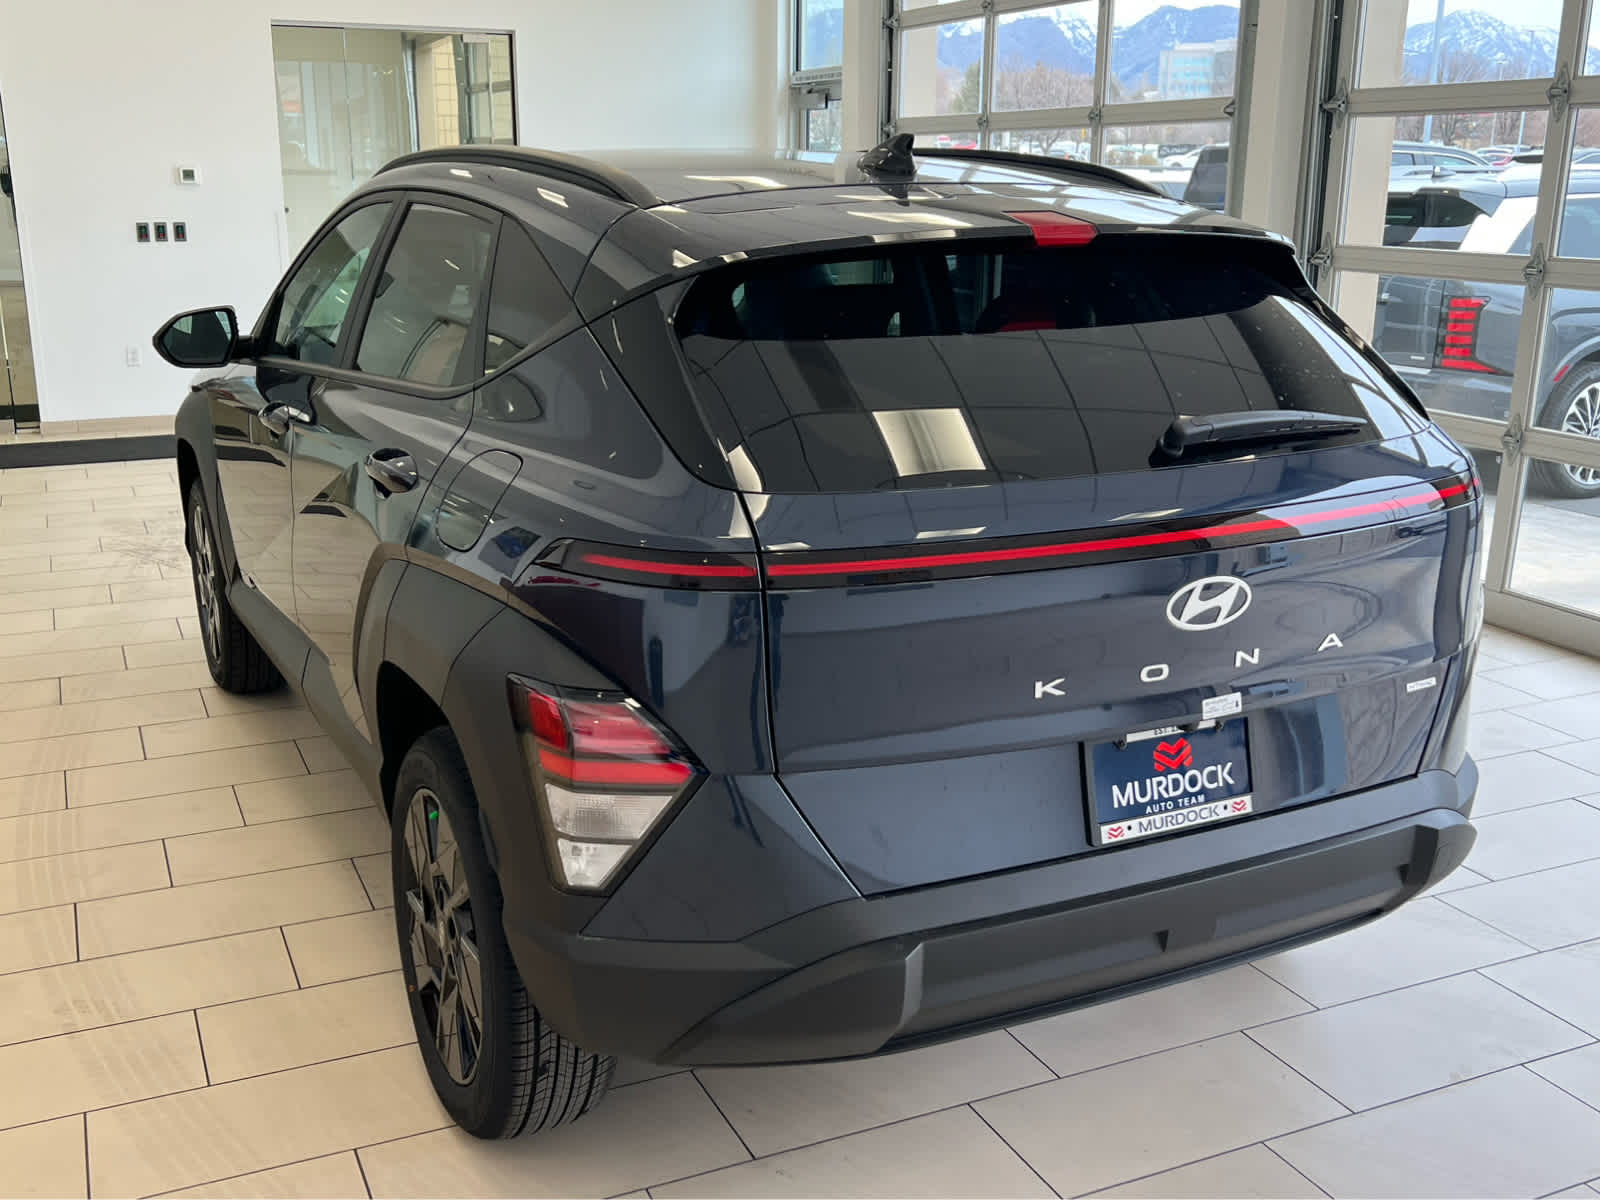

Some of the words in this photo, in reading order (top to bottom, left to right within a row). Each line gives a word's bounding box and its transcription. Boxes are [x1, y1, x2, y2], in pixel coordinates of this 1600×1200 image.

[1034, 633, 1344, 699] KONA
[1111, 762, 1235, 808] MURDOCK
[1138, 805, 1220, 833] MURDOCK
[1145, 801, 1174, 815] AUTO
[1178, 794, 1205, 807] TEAM
